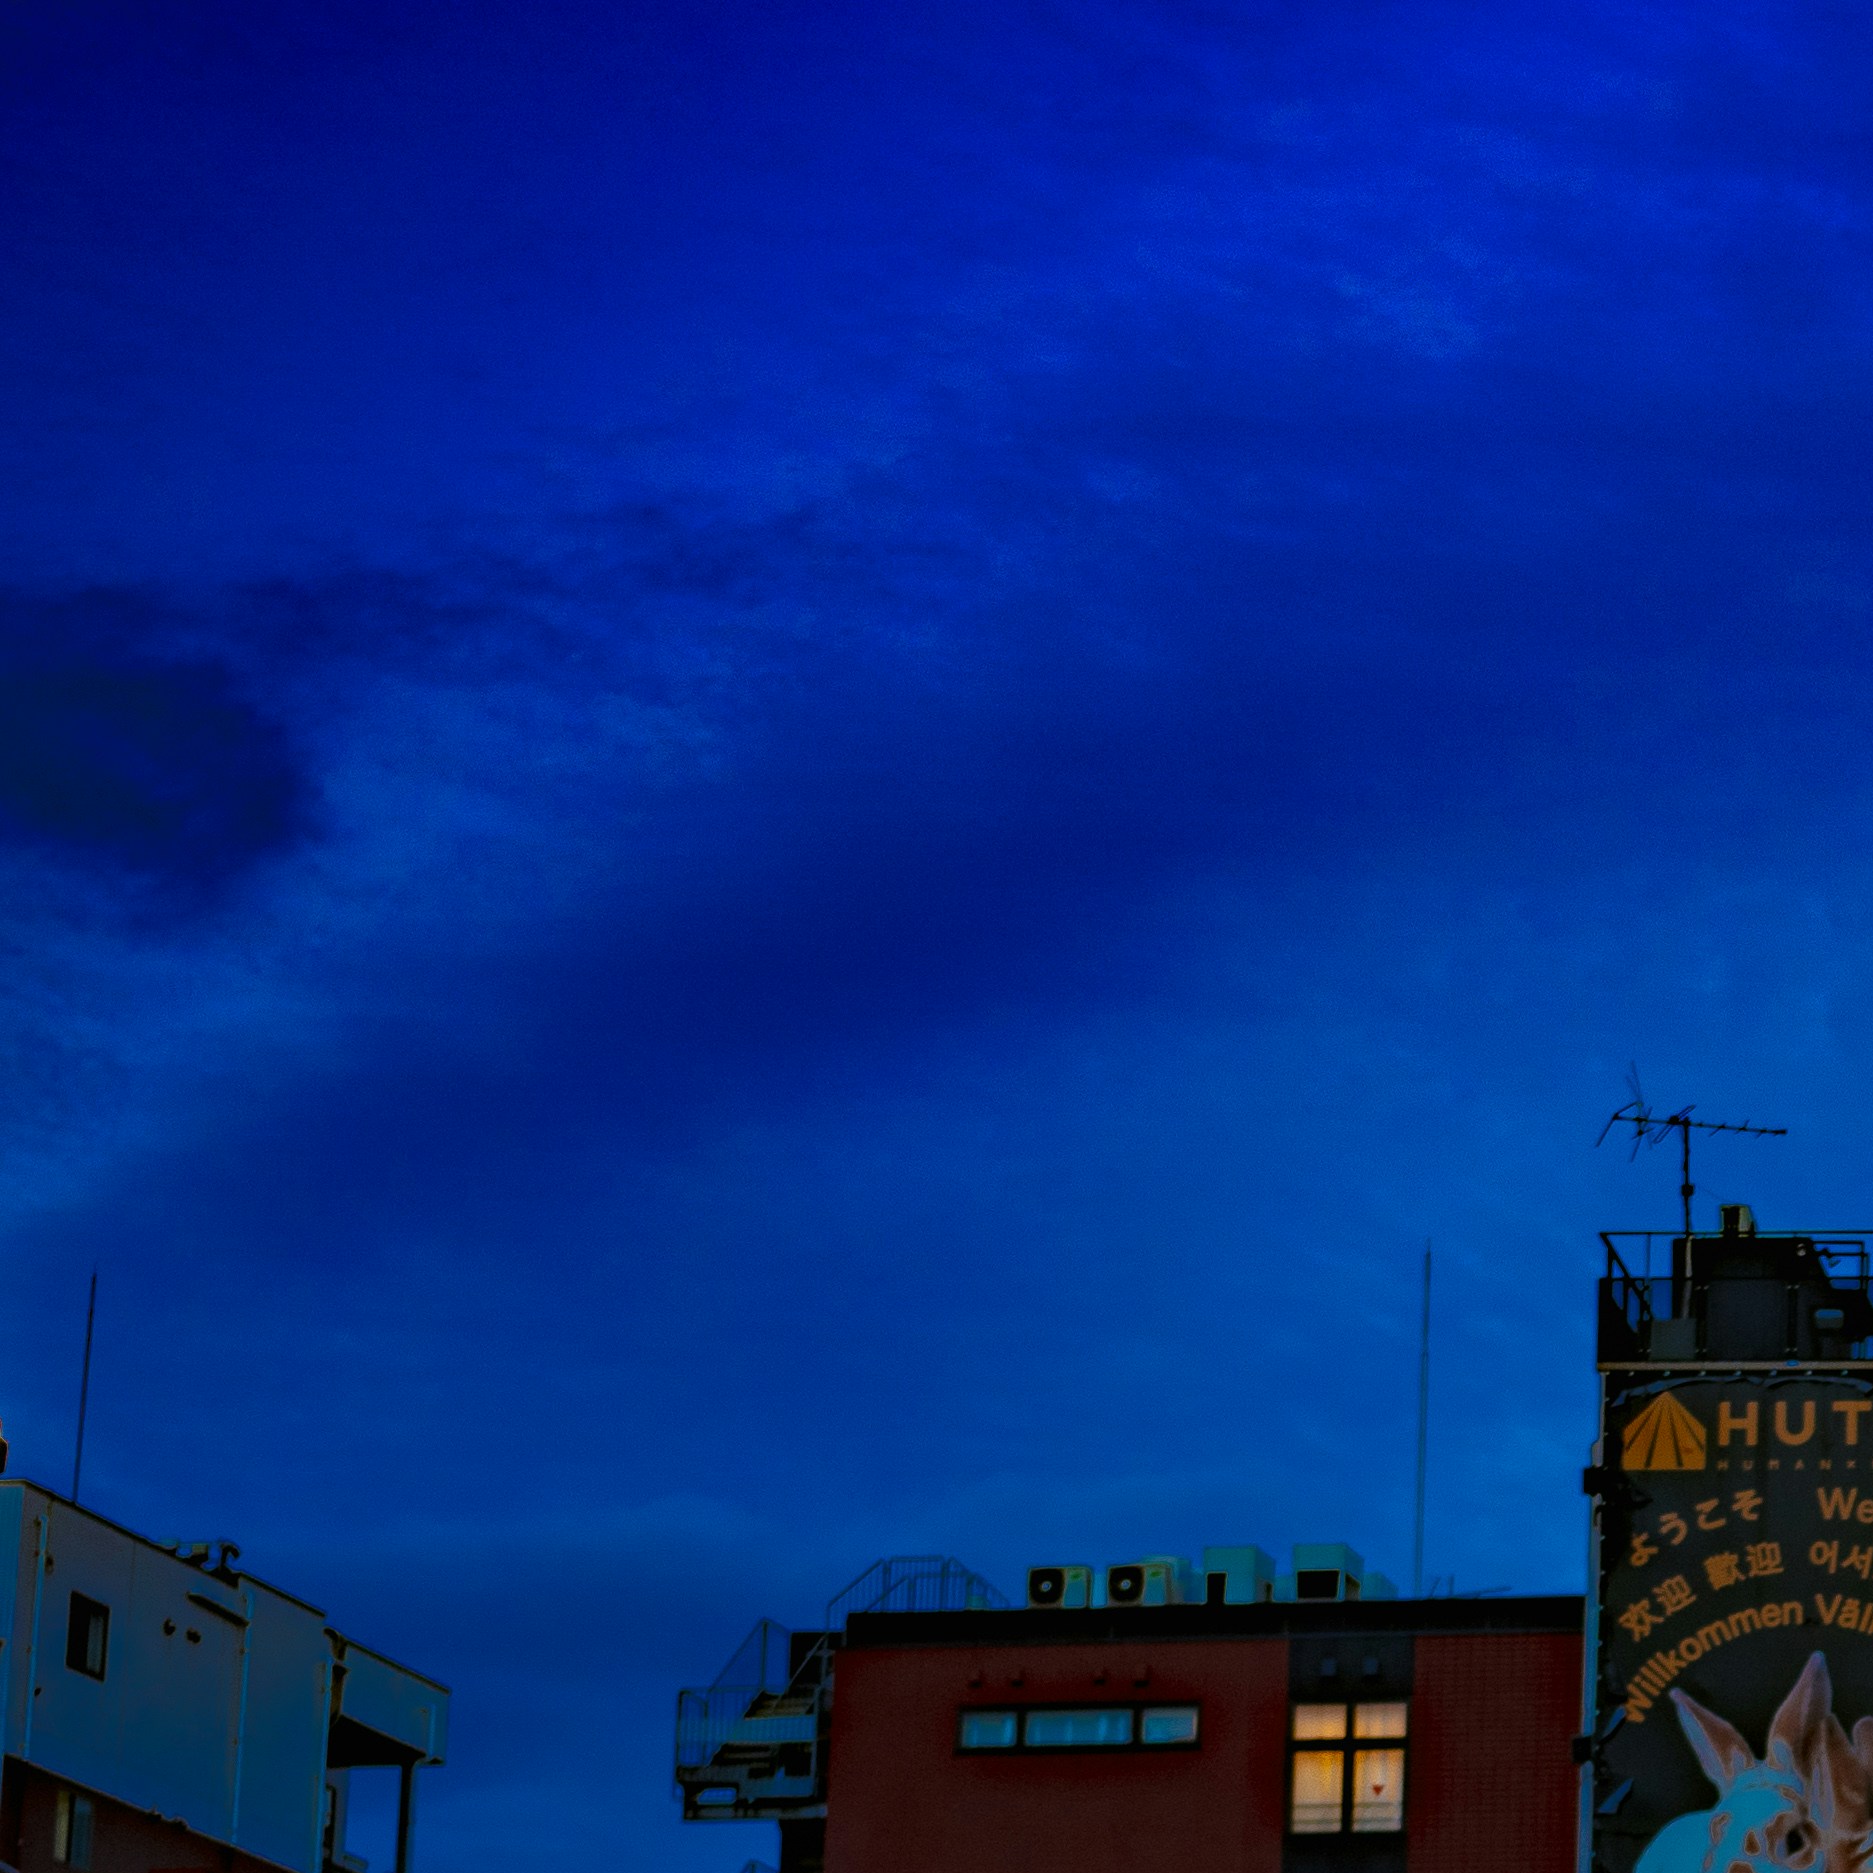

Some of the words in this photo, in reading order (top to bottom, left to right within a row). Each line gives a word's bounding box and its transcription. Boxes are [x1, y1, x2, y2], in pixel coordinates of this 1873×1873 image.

[1629, 1488, 1763, 1566] ようこそ
[1618, 1574, 1697, 1641] 欢迎
[1703, 1541, 1784, 1591] 歡迎
[1625, 1600, 1804, 1723] Willkommen
